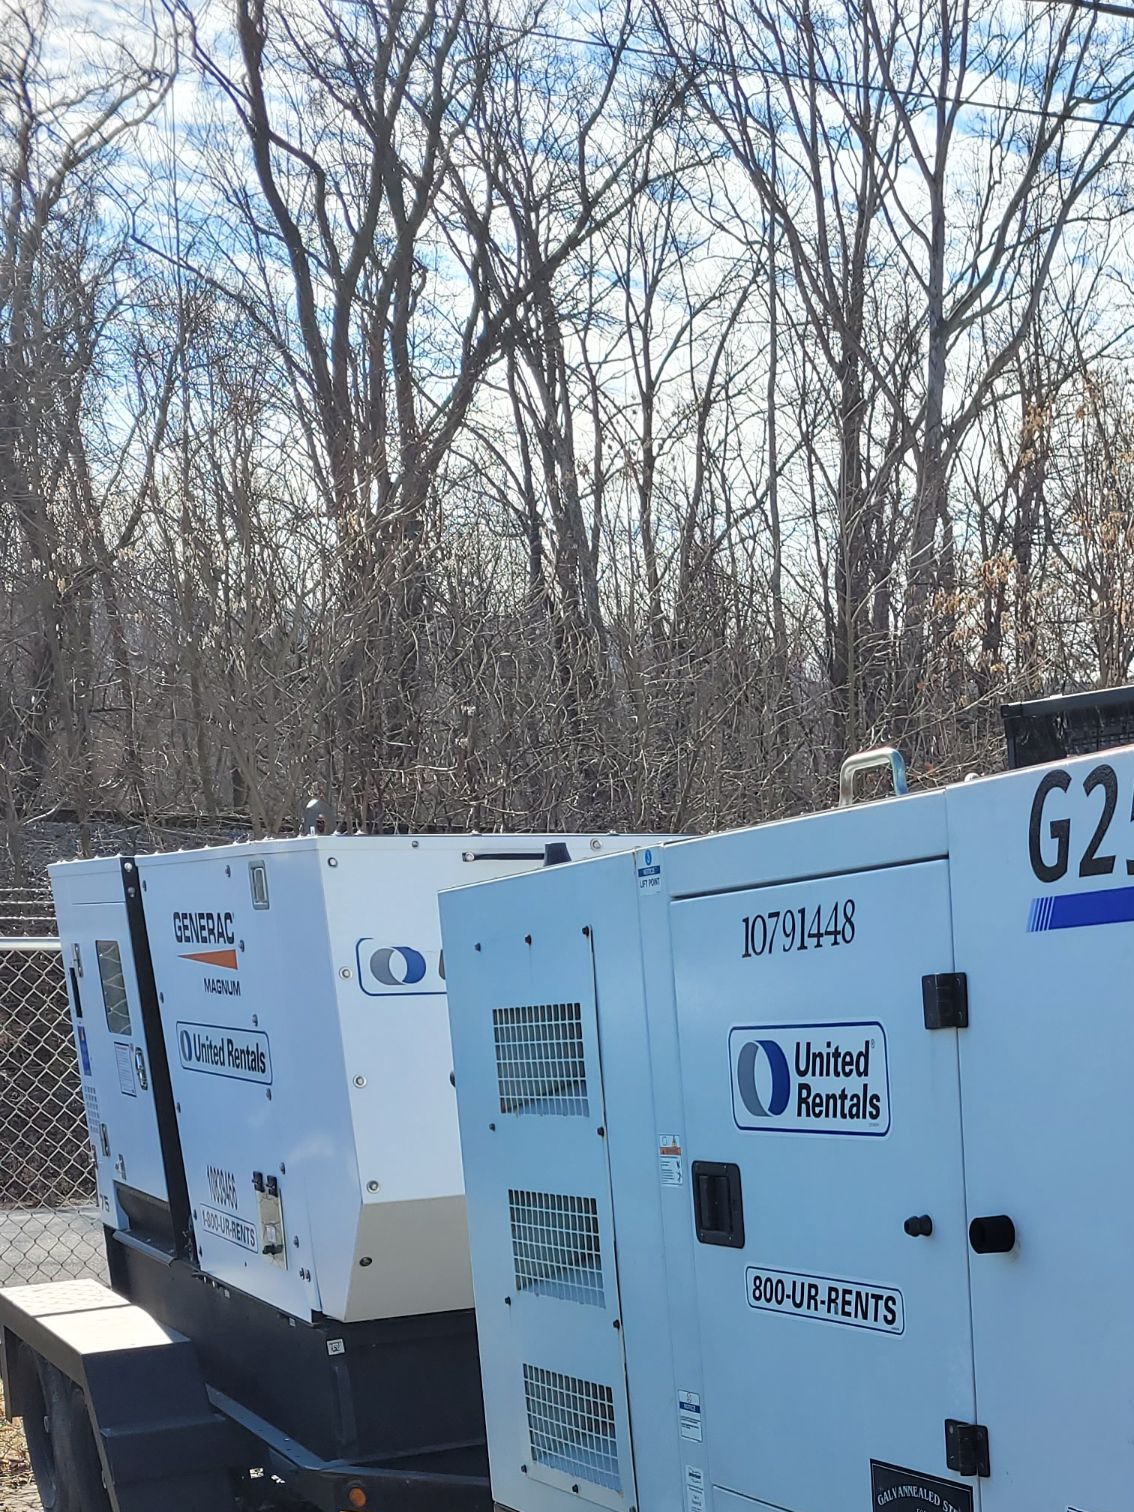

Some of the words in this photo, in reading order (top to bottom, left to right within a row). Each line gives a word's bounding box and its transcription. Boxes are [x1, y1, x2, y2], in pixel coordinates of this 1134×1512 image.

[172, 911, 235, 944] GENERAC
[741, 898, 856, 958] 10791448
[203, 977, 242, 996] MAGNUM
[193, 1033, 225, 1067] United
[227, 1038, 267, 1074] Rentals
[794, 1039, 870, 1078] United
[796, 1082, 881, 1120] Rentals
[202, 1209, 256, 1248] 1-800-UR-RENTS
[752, 1275, 897, 1326] 800-UR-RENTS
[877, 1485, 941, 1506] GALVANNEALED
